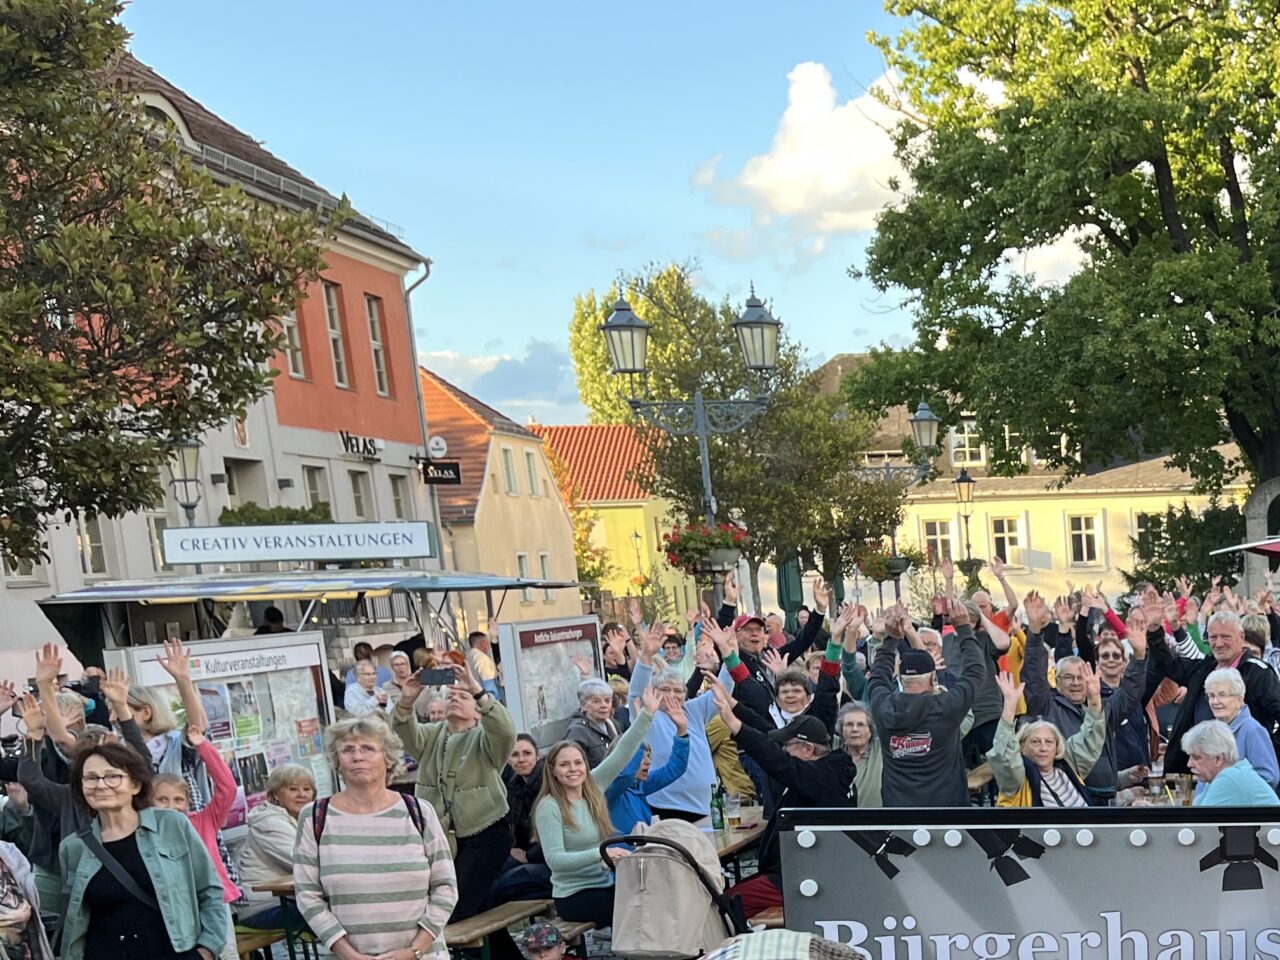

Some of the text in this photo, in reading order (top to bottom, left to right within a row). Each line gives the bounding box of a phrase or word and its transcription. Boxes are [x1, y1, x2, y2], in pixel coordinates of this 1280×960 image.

[339, 430, 377, 456] VELAS
[180, 532, 414, 552] CREATIV VERANSTALTUNGEN
[204, 653, 288, 674] Kulturveranstaltungen
